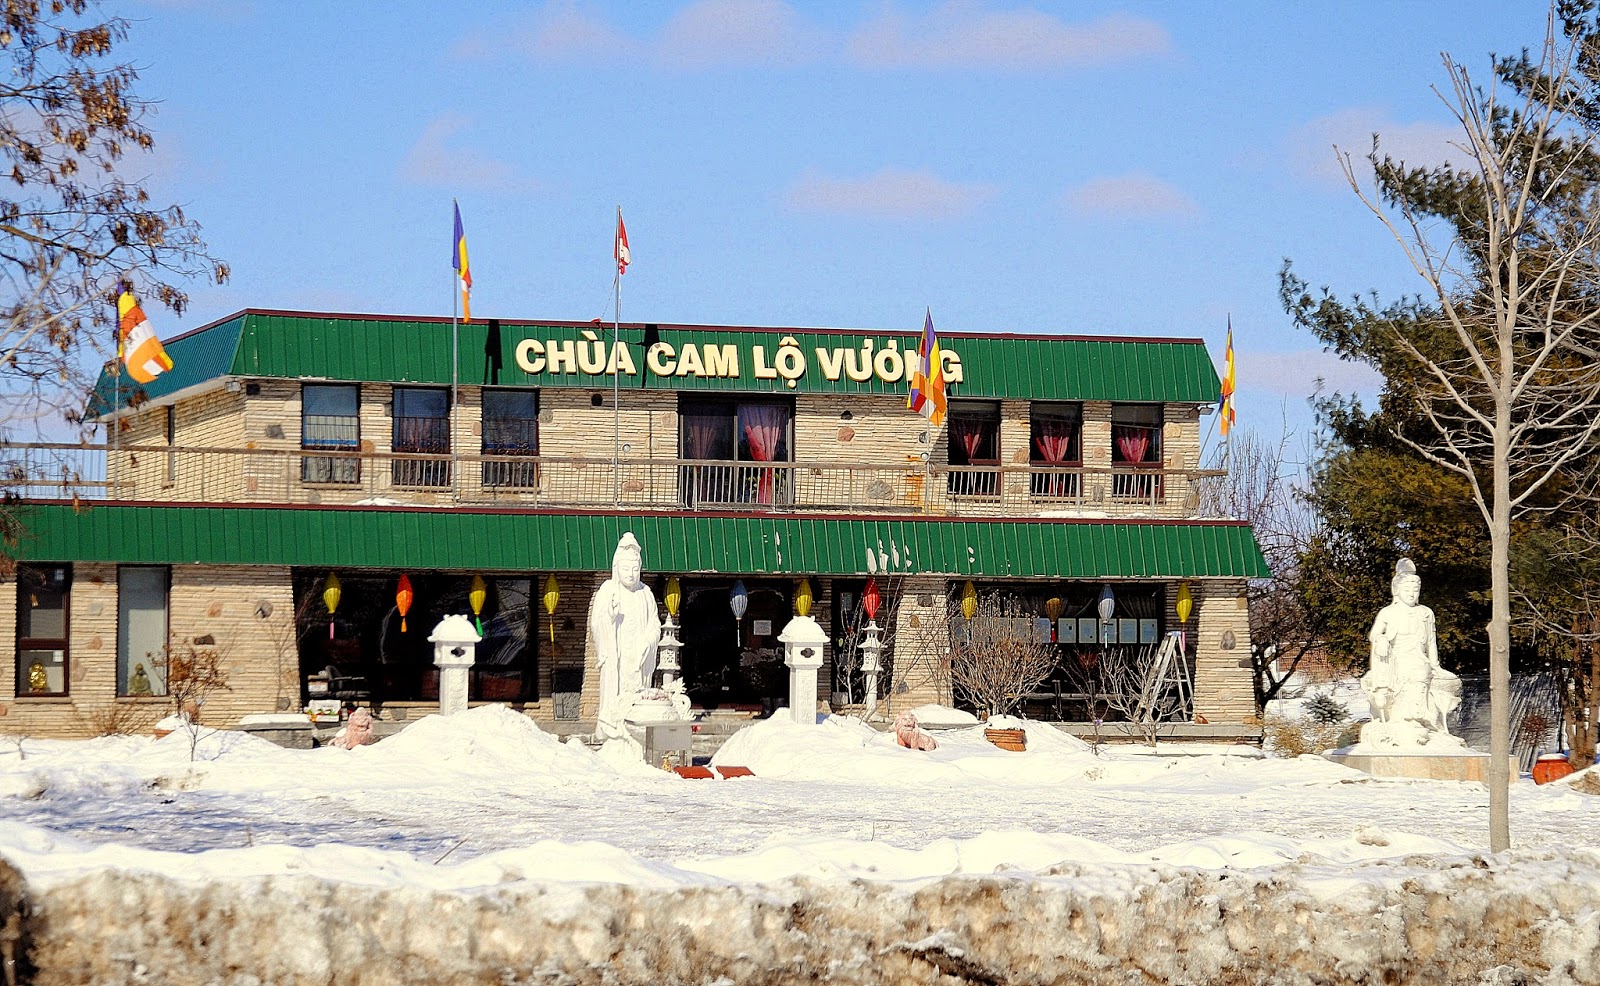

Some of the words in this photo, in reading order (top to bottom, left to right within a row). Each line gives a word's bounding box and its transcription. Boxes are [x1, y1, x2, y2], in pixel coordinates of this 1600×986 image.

[515, 330, 637, 375] CHÙA
[647, 342, 740, 377] CAM
[753, 336, 806, 389] LỘ
